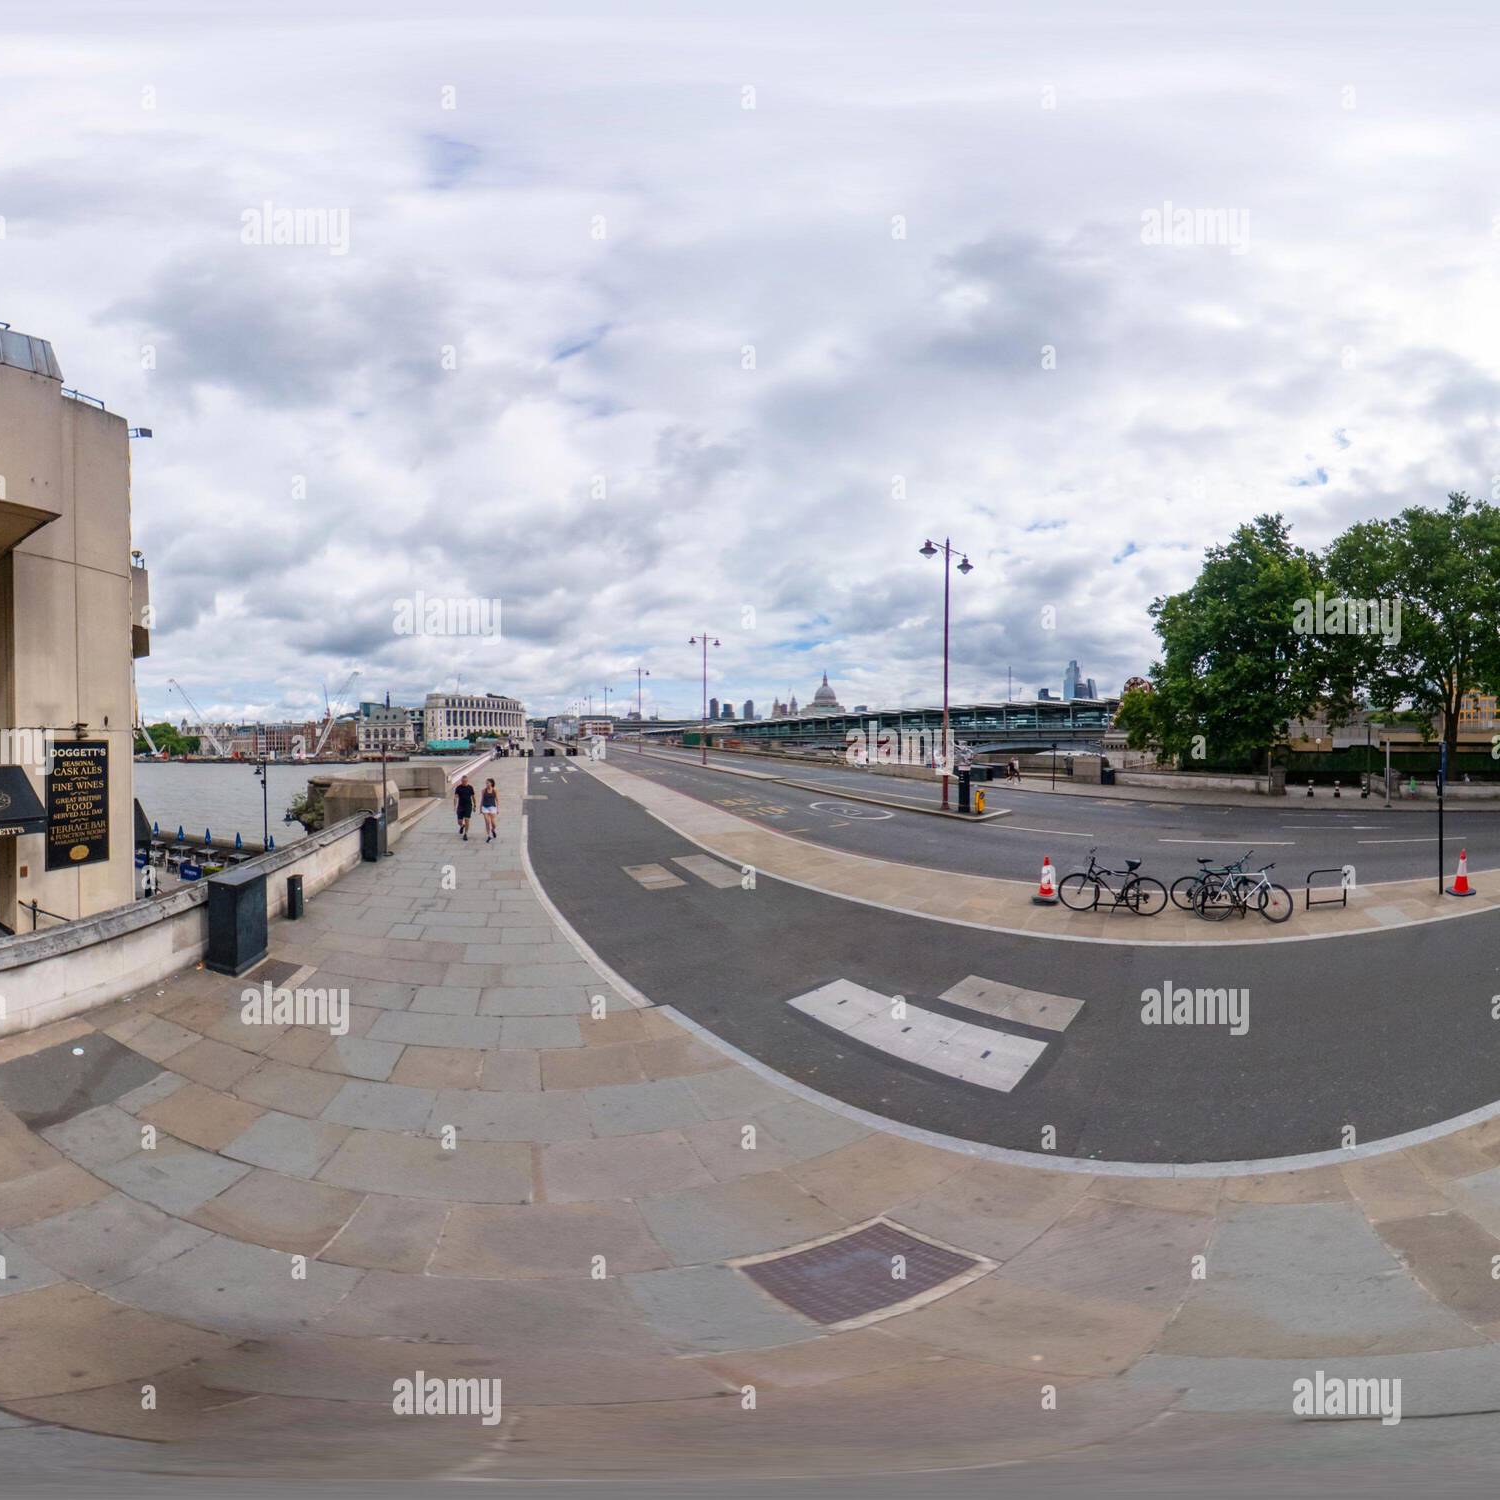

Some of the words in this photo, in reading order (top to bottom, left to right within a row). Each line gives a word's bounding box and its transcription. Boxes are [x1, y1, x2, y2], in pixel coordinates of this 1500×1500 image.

[50, 748, 106, 757] DOGGETT'S
[54, 768, 79, 776] CASK
[81, 766, 102, 775] ALES
[52, 783, 73, 792] FINE
[76, 781, 104, 790] WINES
[66, 802, 92, 812] FOOD
[53, 811, 78, 819] SERVED
[51, 823, 89, 834] TERRACE
[91, 820, 106, 828] BAR
